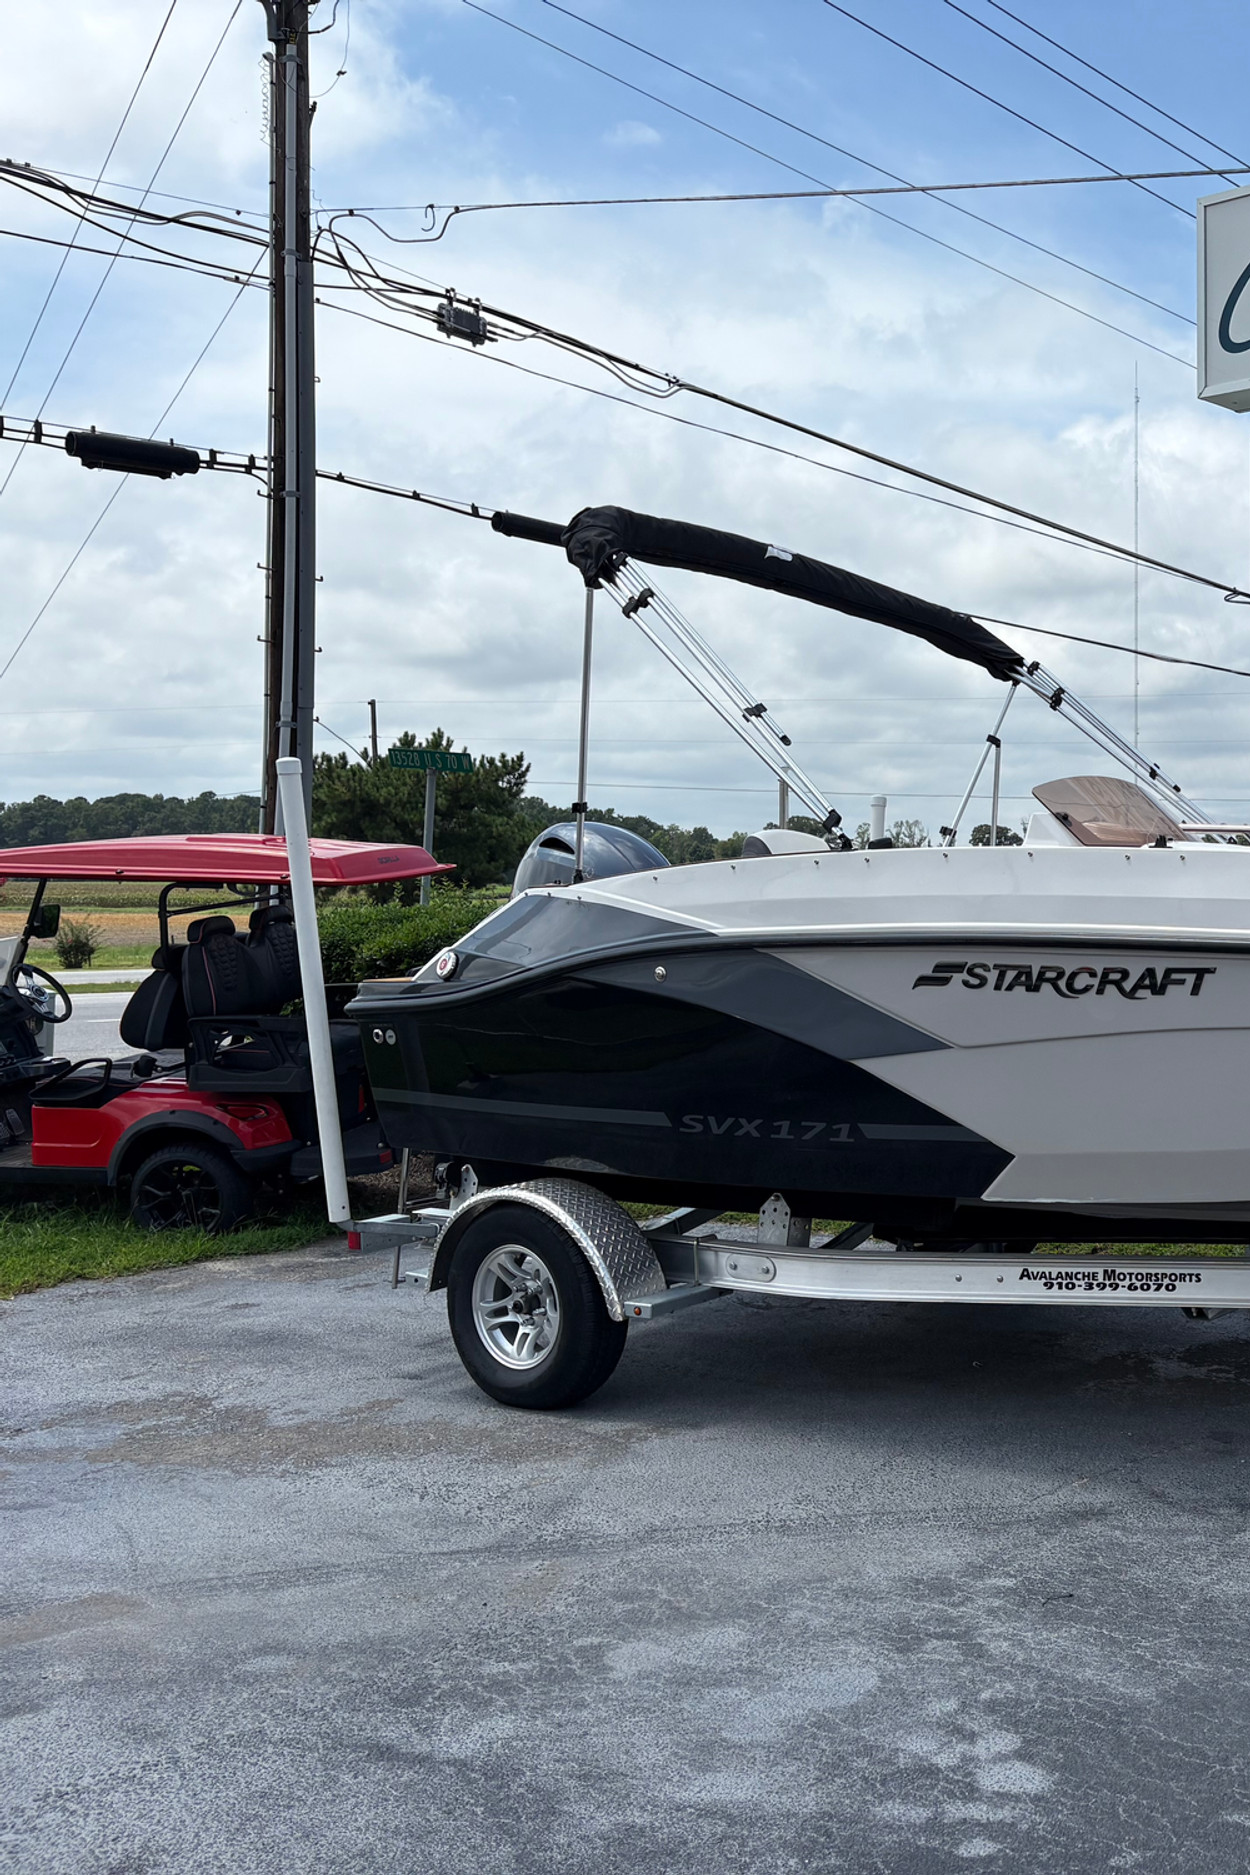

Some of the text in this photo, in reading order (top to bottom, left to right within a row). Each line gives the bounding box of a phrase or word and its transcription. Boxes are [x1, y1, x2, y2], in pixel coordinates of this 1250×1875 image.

[435, 753, 443, 768] S
[445, 754, 458, 769] 70
[461, 755, 470, 770] W
[961, 962, 1217, 1000] STARCRAFT
[679, 1115, 855, 1142] SVX 171
[1018, 1268, 1202, 1283] AVALANCHE MOTORSPORTS
[1043, 1281, 1177, 1292] 910-399-6070
